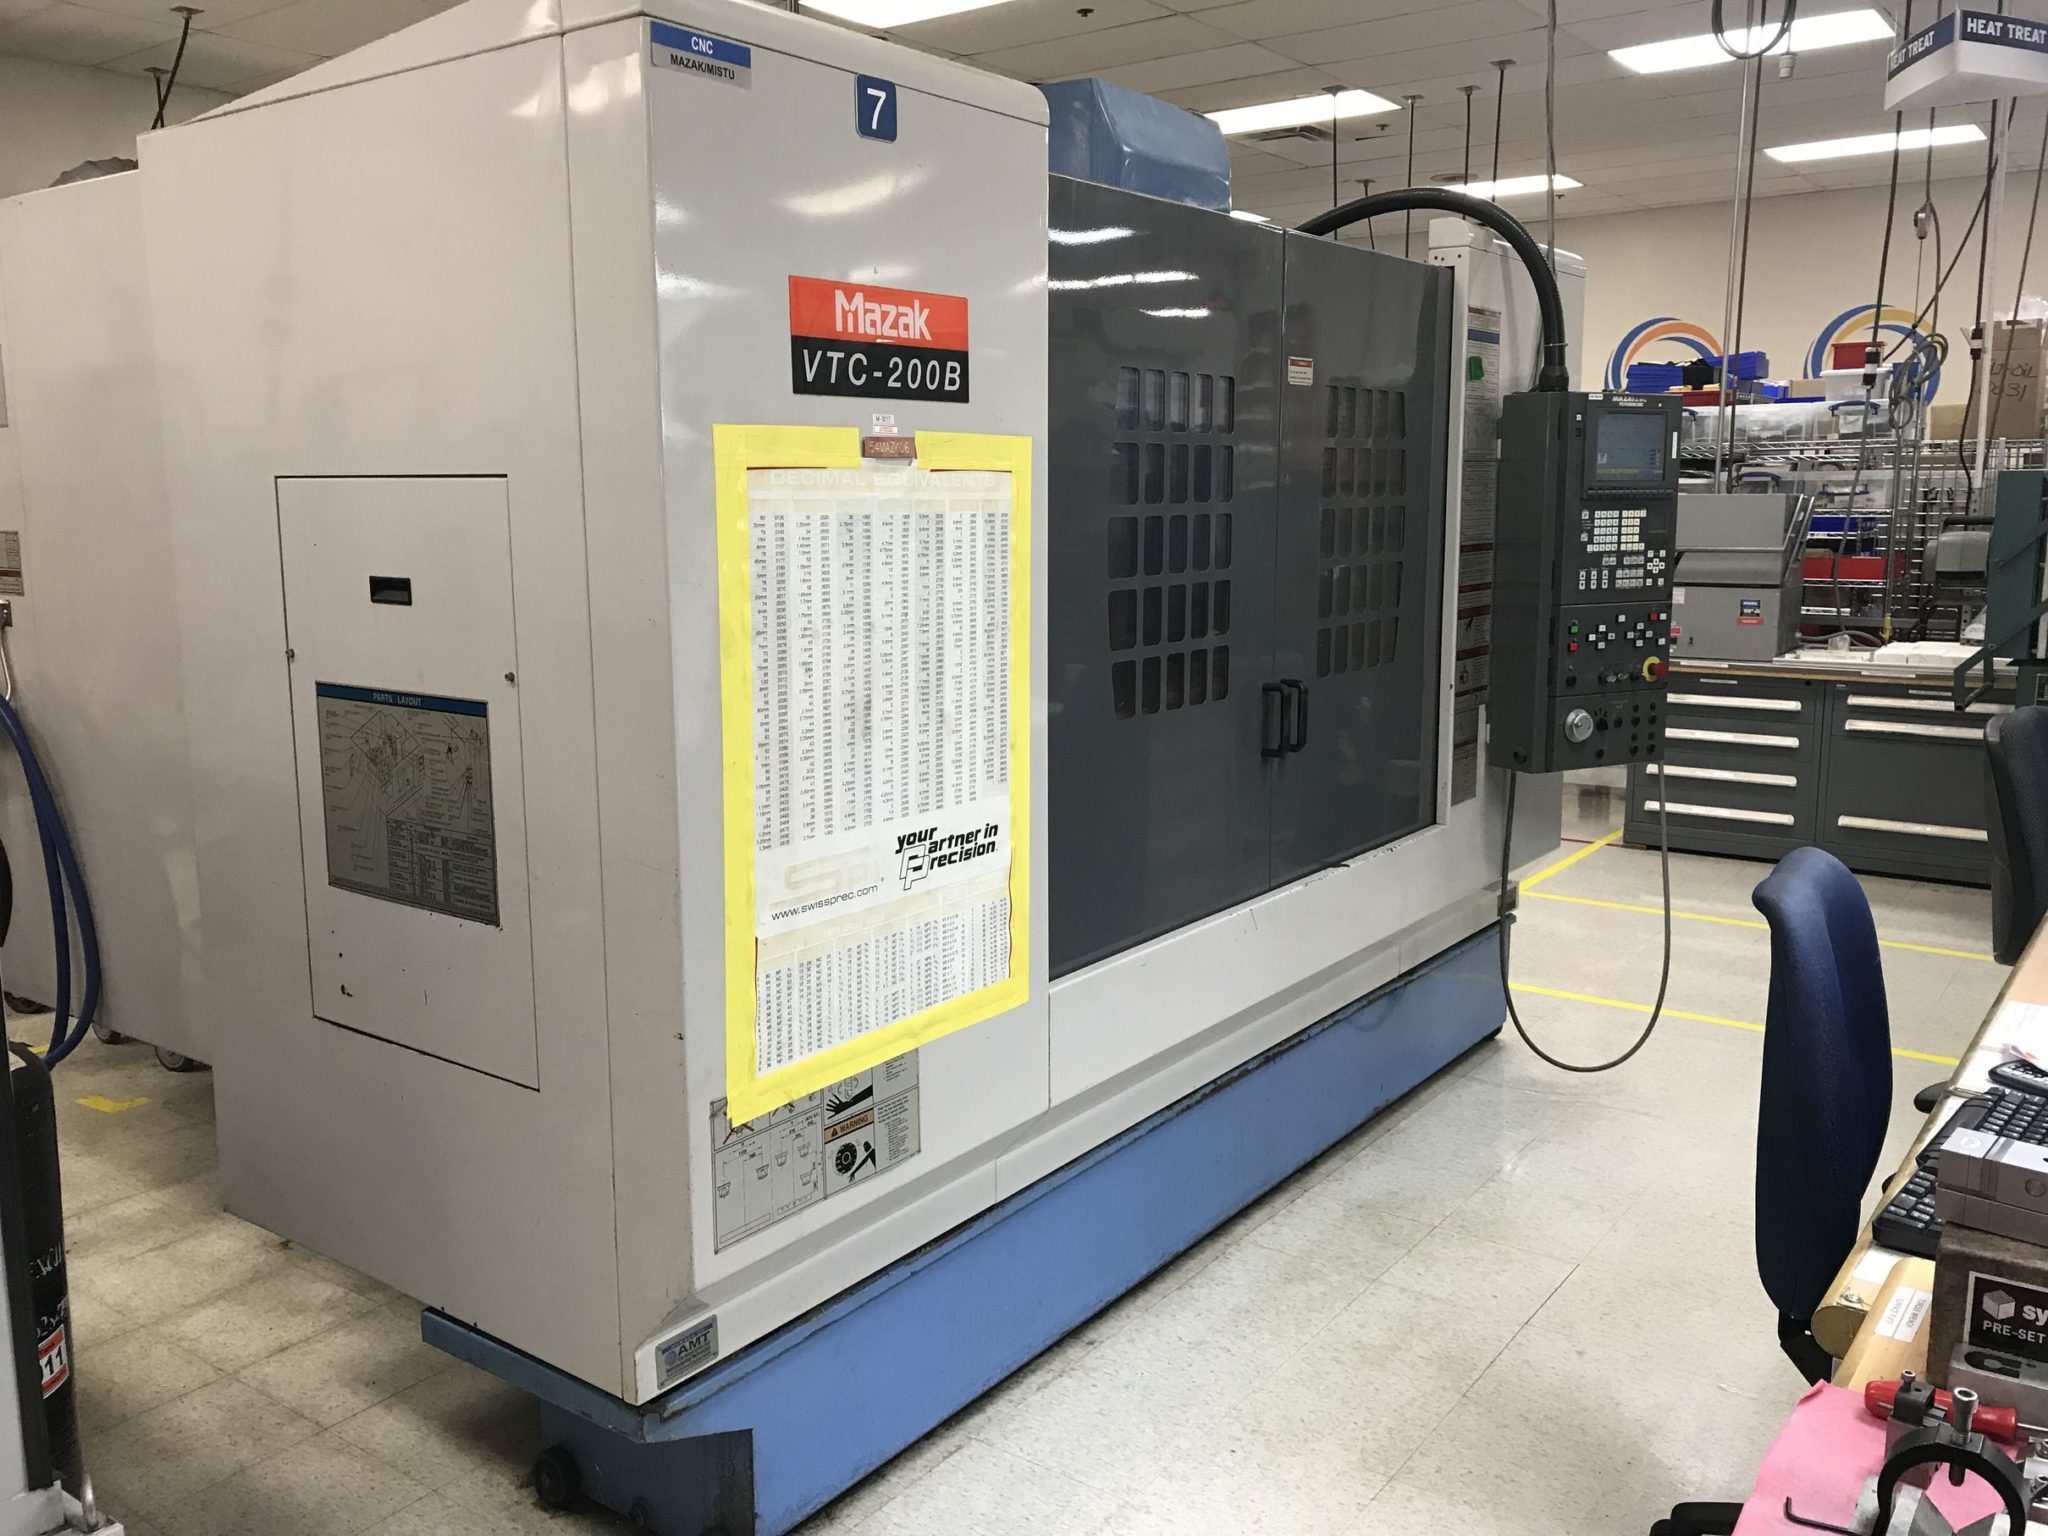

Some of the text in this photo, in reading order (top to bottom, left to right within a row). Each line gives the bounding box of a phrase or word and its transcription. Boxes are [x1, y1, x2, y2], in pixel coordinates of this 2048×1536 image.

[1966, 17, 2048, 45] HEAT TREAT
[691, 36, 714, 55] CNC
[1907, 30, 1935, 60] TREAT
[670, 53, 735, 80] MAZAK/MISTU
[866, 87, 887, 130] 7
[834, 289, 933, 341] Mazak
[802, 349, 962, 392] VTC-200B
[372, 692, 422, 707] PARTS LAYOUT
[895, 826, 938, 854] your
[983, 823, 999, 840] in
[770, 884, 878, 921] www.swissprec.com
[839, 1114, 869, 1133] WARNING
[677, 1330, 711, 1356] AMT
[1982, 1319, 2047, 1344] PRE-SET
